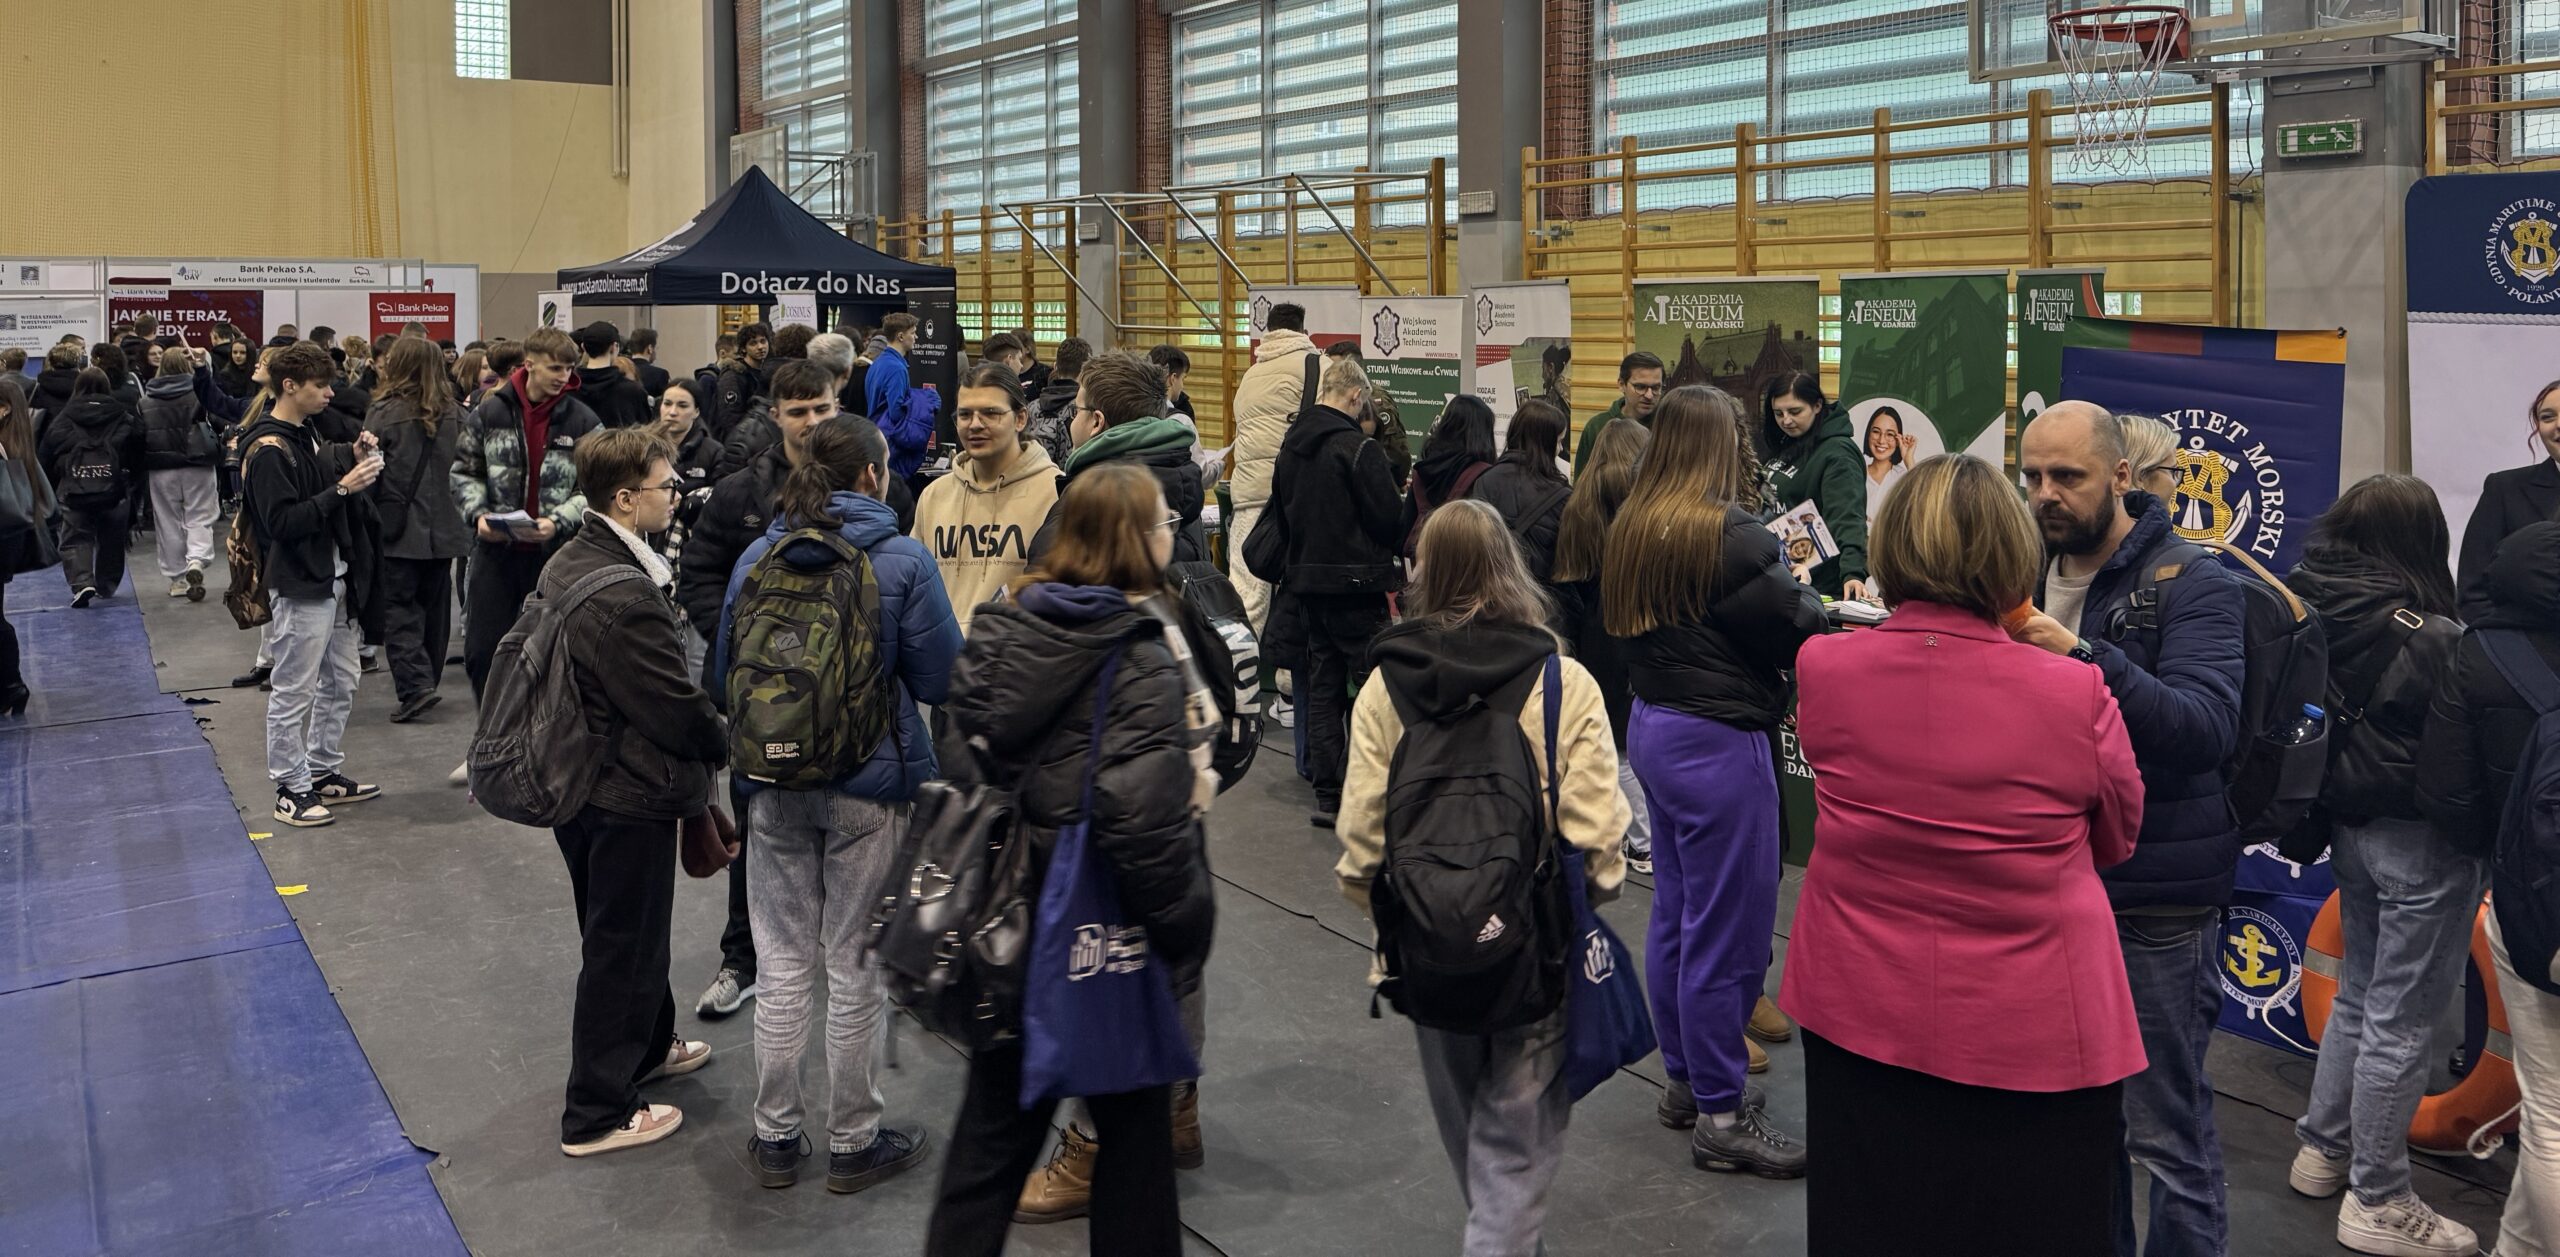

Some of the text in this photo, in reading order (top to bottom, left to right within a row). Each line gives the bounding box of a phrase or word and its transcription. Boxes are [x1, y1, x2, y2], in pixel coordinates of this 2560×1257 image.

[2486, 198, 2556, 284] GDYNIA MARITIME
[240, 265, 316, 273] Bank Pekao S.A.
[817, 270, 849, 294] do
[856, 273, 901, 295] Nas
[1672, 294, 1744, 305] AKADEMIA
[2037, 288, 2074, 301] AKADEMIA
[398, 303, 449, 312] Bank Pekao
[1865, 299, 1917, 308] AKADEMIA
[111, 309, 141, 324] JAK
[176, 310, 232, 323] TERAZ,
[1402, 316, 1437, 327] Wojskowa
[1684, 321, 1693, 329] W
[2043, 322, 2048, 331] W
[1402, 327, 1437, 336] Akademia
[1402, 337, 1437, 347] Techniczna
[1366, 365, 1390, 374] STUDIA
[72, 464, 112, 478] VANS
[2242, 441, 2285, 559] MORSKI
[934, 524, 1027, 560] NASA
